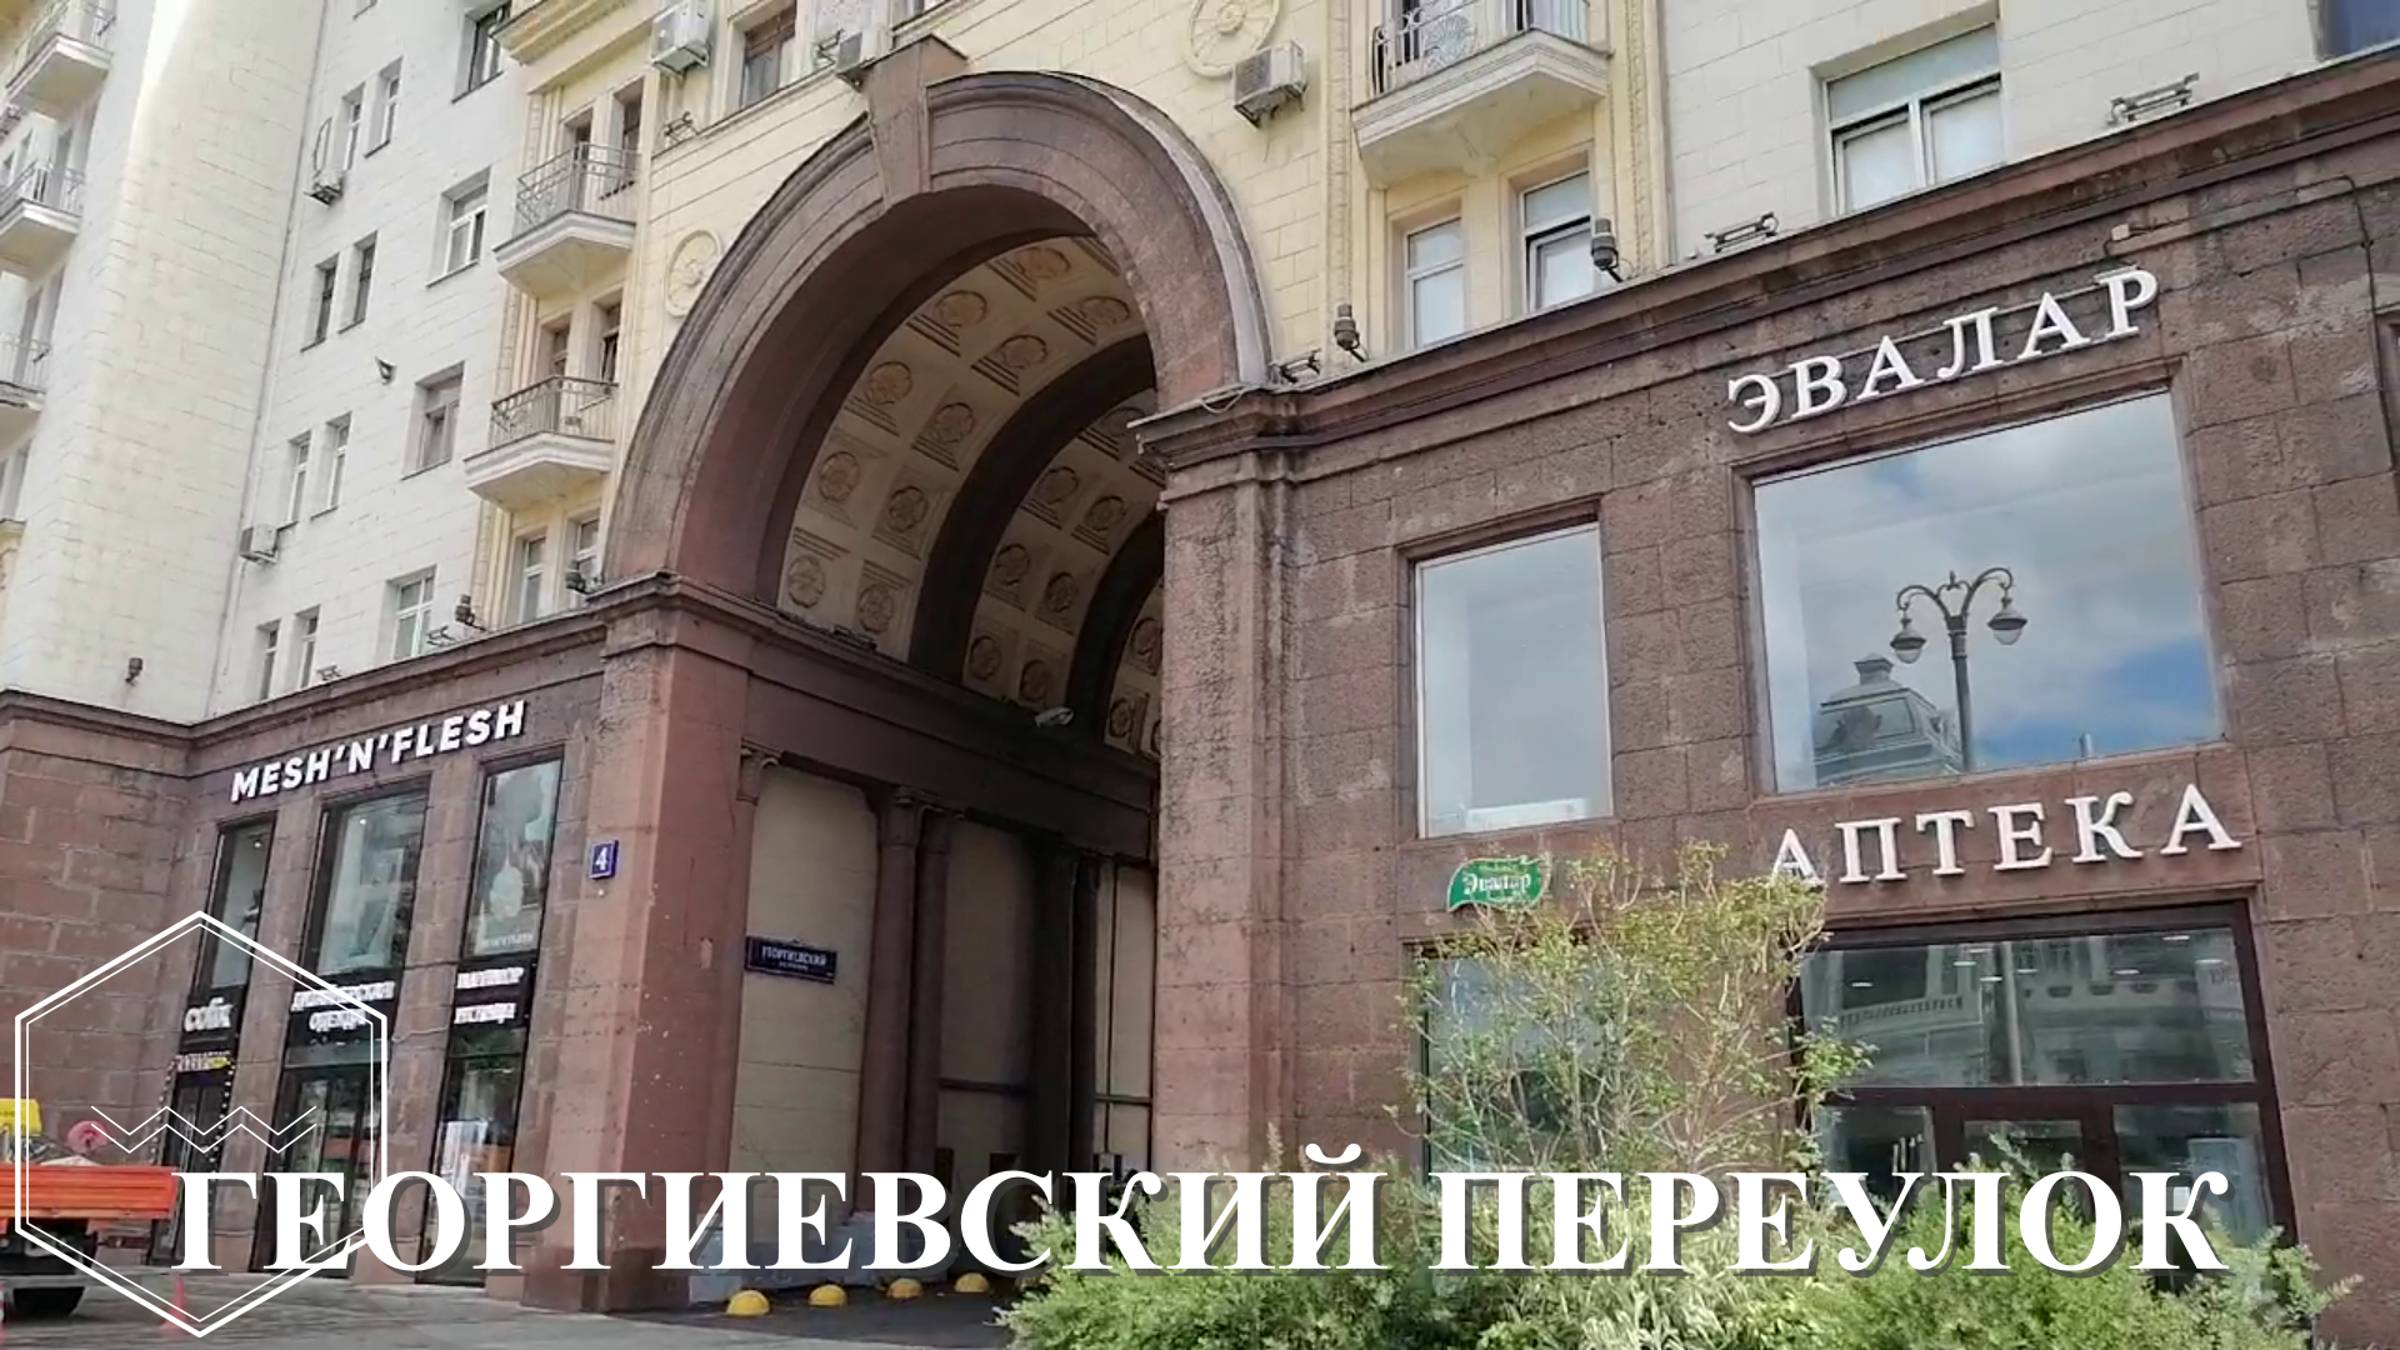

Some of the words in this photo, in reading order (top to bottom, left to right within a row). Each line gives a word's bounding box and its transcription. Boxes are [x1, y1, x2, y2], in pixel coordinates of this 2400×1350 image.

[1727, 269, 2160, 434] ЭВАЛАР
[595, 846, 608, 871] 4
[1770, 783, 2244, 888] АПТЕКА
